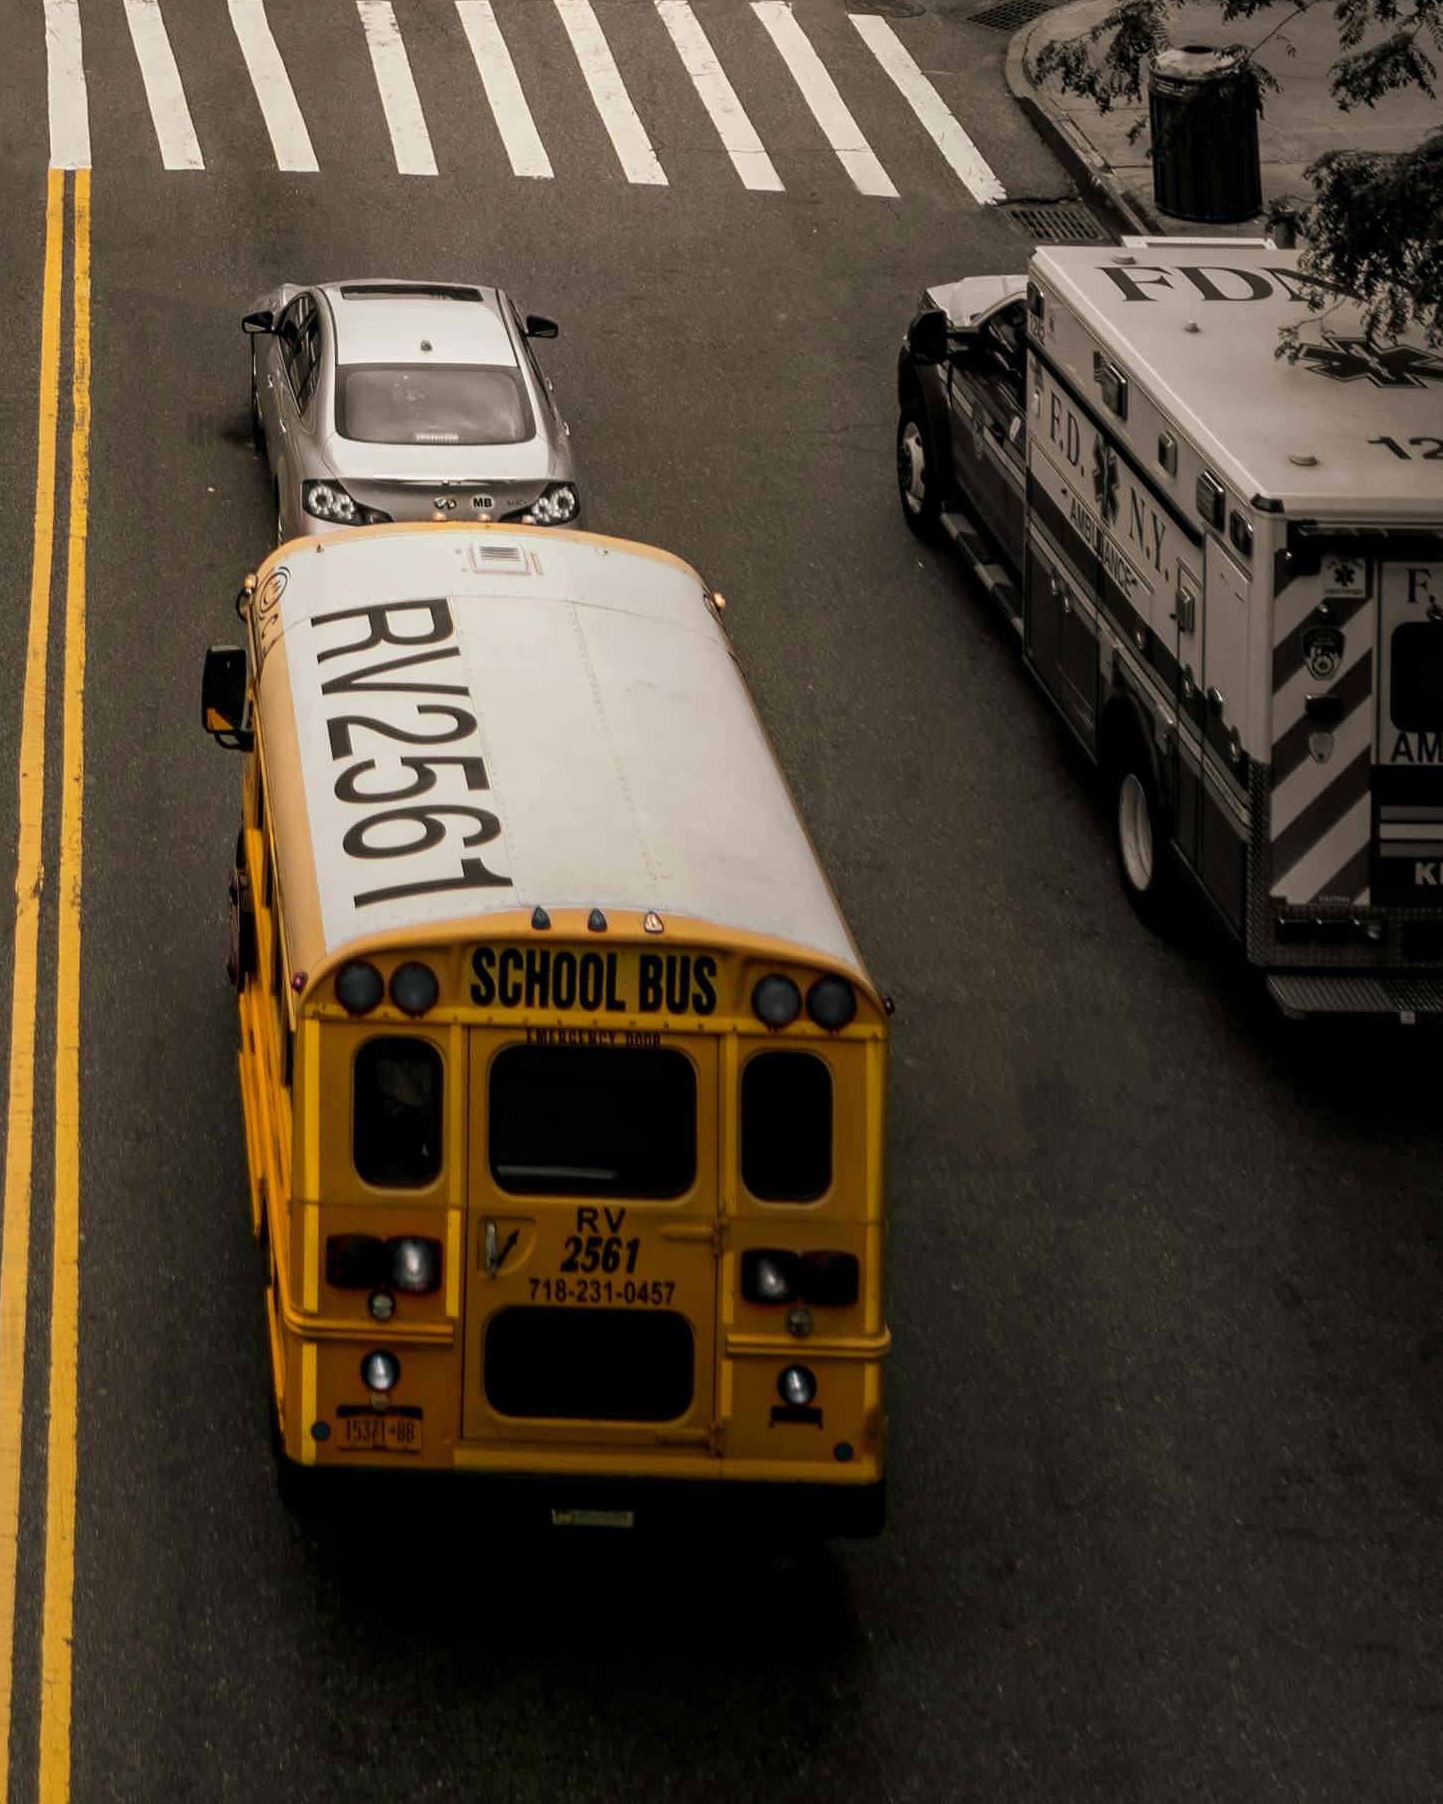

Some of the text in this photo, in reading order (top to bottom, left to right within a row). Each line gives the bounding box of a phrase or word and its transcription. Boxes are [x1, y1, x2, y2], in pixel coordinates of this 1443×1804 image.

[473, 498, 492, 507] MB
[1070, 497, 1132, 594] AMBULANCE
[310, 597, 514, 909] RV2561
[471, 947, 717, 1014] SCHOOL BUS
[526, 1029, 662, 1047] EMERGENCY DOOR
[577, 1208, 626, 1233] RV
[560, 1236, 640, 1274] 2561
[529, 1278, 676, 1305] 718-231-0457
